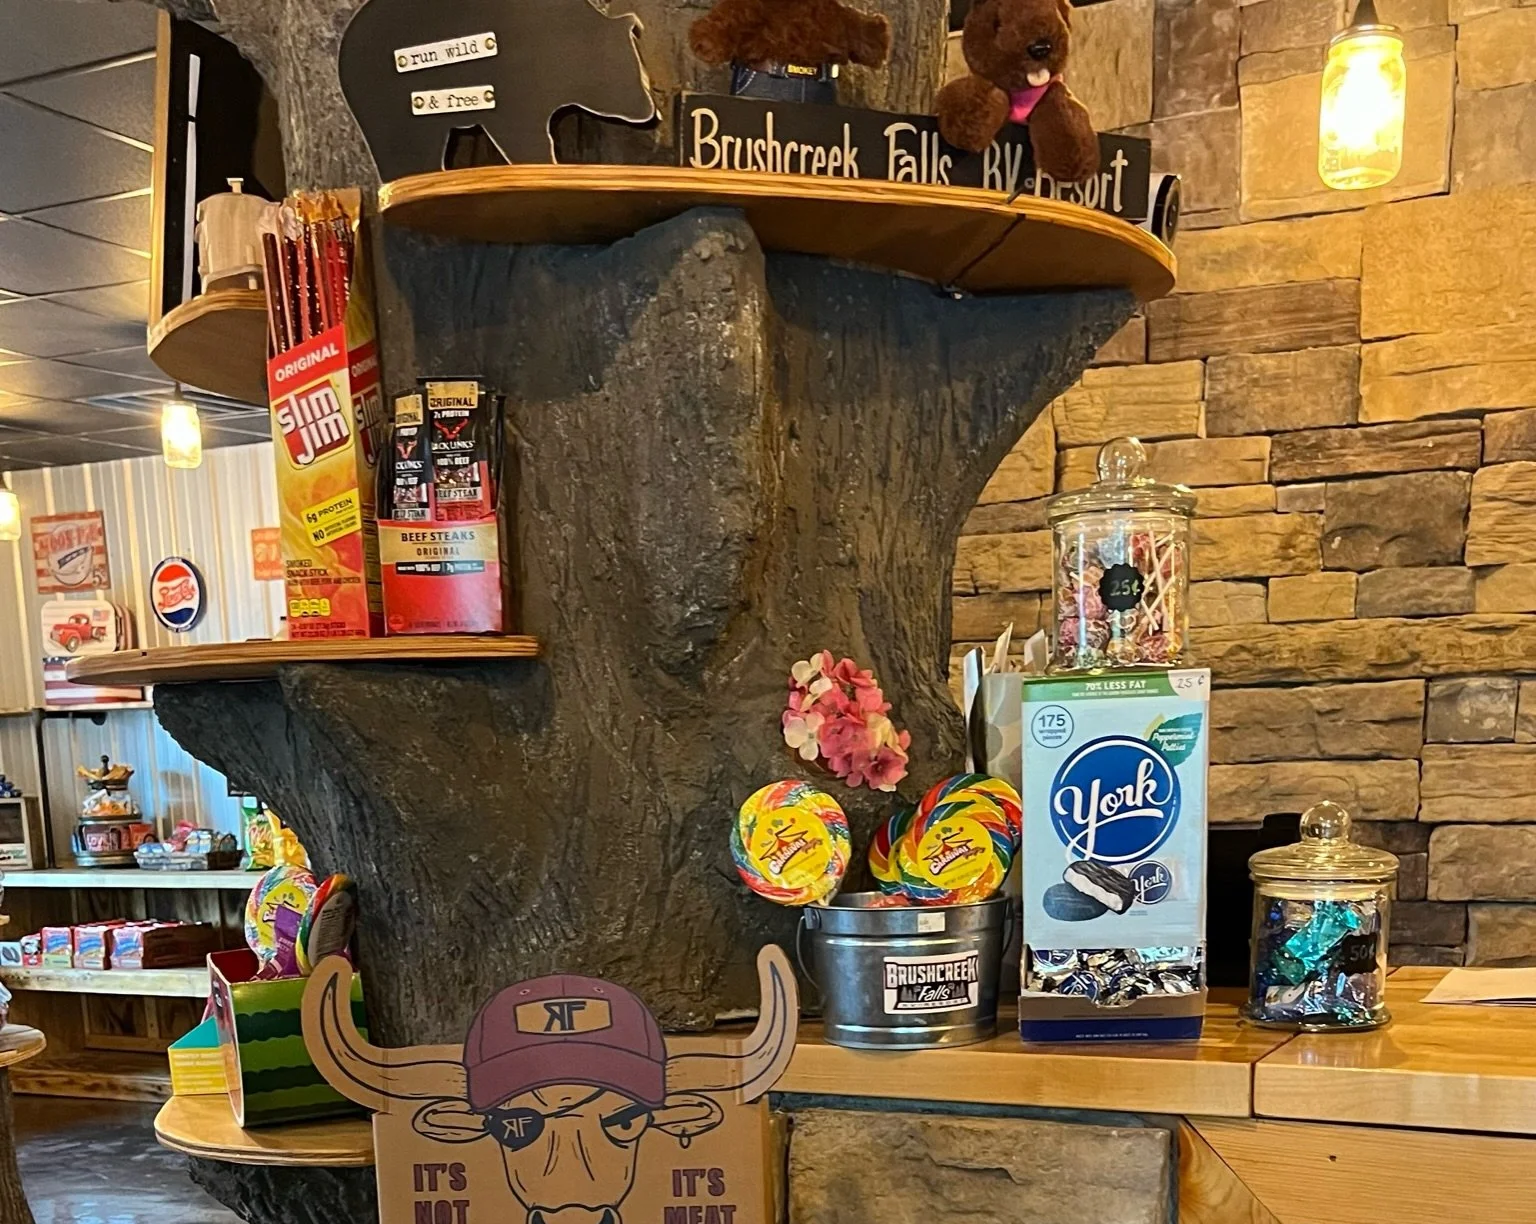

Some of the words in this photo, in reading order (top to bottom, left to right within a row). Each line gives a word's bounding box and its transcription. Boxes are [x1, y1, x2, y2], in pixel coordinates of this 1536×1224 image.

[410, 51, 438, 65] run
[445, 40, 480, 58] wild
[428, 95, 439, 109] &
[447, 94, 479, 108] free
[689, 108, 859, 178] Brushcreek
[884, 122, 952, 185] Falls
[983, 139, 1023, 194] RV
[275, 342, 340, 382] ORIGINAL
[429, 397, 474, 408] ORIGINAL
[452, 487, 477, 497] STEAK
[306, 512, 318, 523] 6g
[318, 497, 353, 517] PROTEIN
[313, 529, 325, 541] NO
[401, 532, 428, 542] BEEF
[430, 531, 476, 541] STEAKS
[416, 547, 461, 556] ORIGINAL
[287, 569, 308, 578] SNACK
[309, 568, 329, 577] STICK
[1108, 577, 1142, 597] 25¢
[1085, 682, 1103, 691] 70%
[1104, 681, 1127, 690] LESS
[1129, 680, 1147, 689] FAT
[1176, 677, 1193, 689] 25
[1038, 714, 1067, 728] 175
[1053, 759, 1170, 858] York
[1131, 867, 1168, 899] York
[886, 957, 977, 988] BRUSHCREEK
[918, 984, 951, 1002] Falls
[413, 1162, 468, 1193] IT'S
[672, 1167, 726, 1198] IT'S
